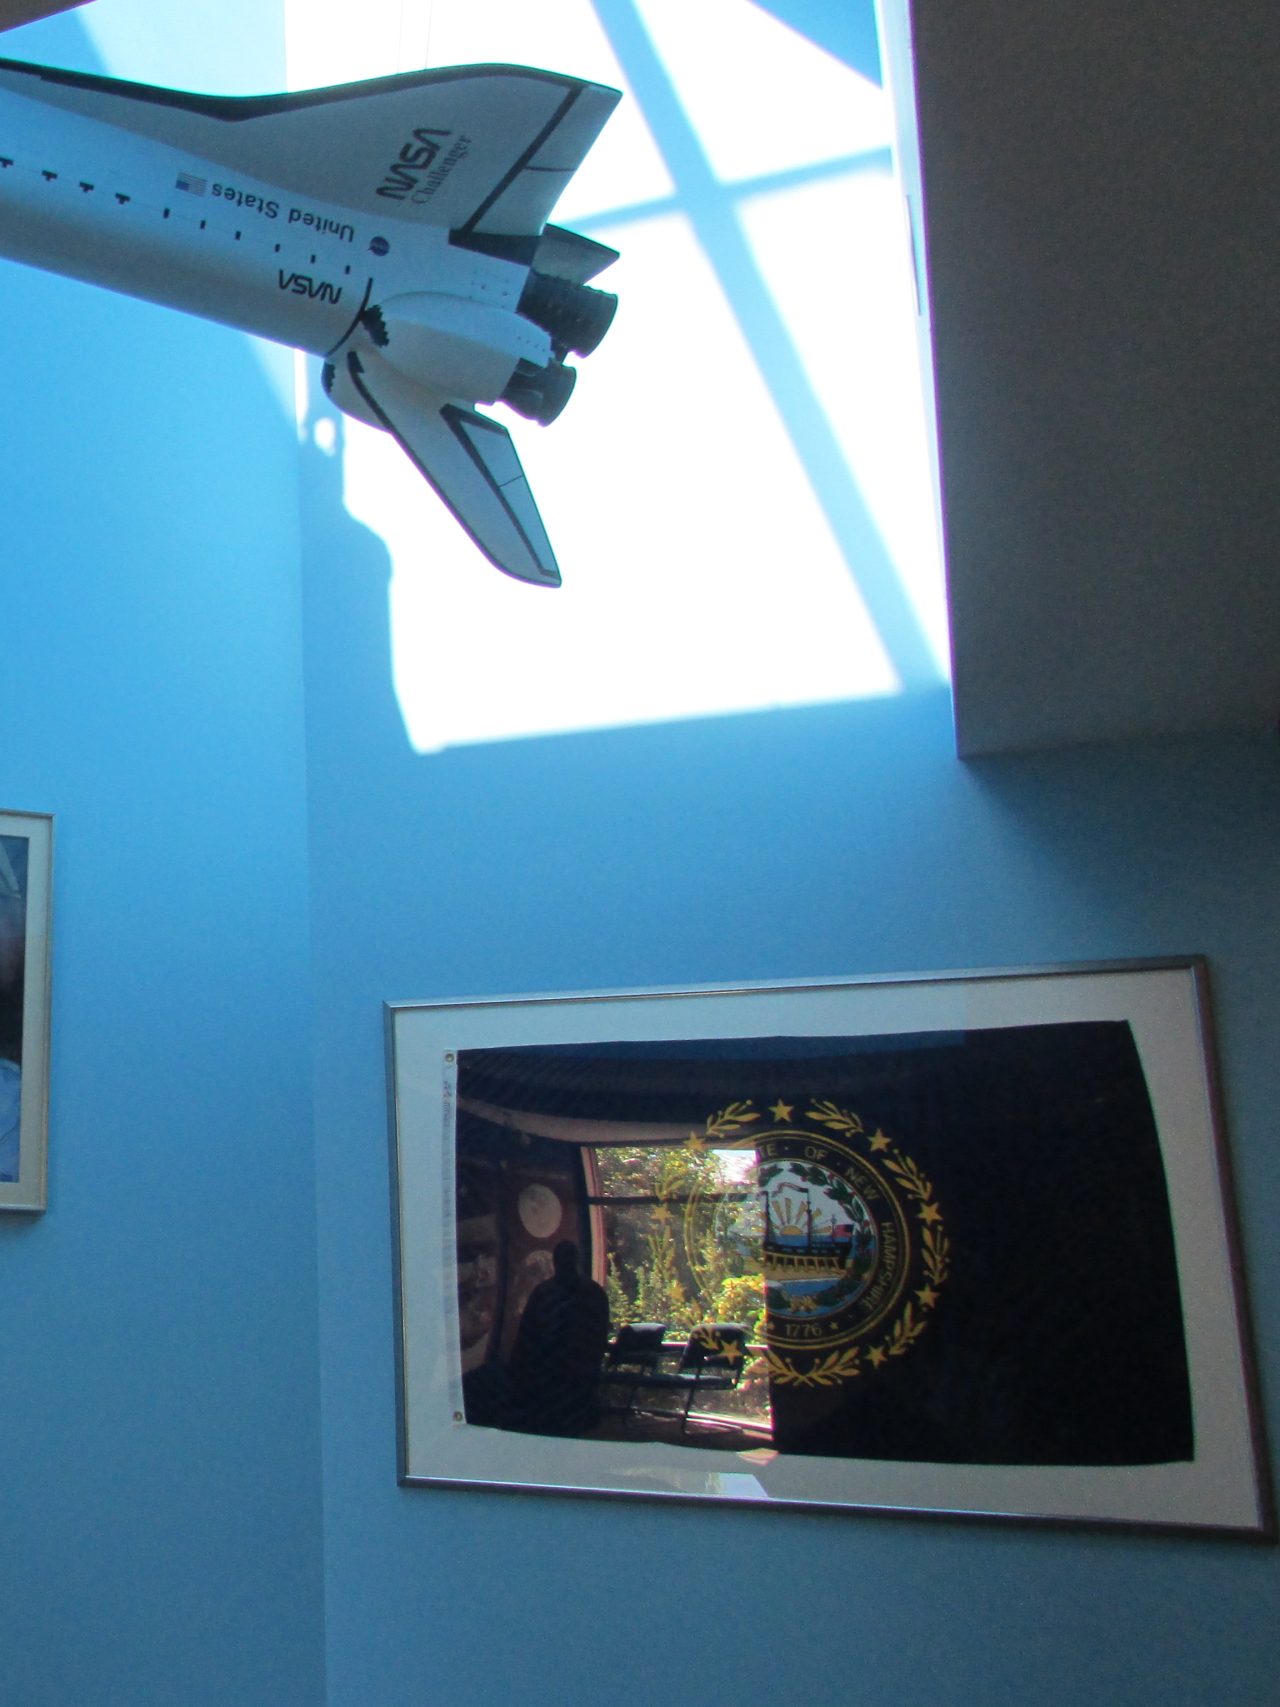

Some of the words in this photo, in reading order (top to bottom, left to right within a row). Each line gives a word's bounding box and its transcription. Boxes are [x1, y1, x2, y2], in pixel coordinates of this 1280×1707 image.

[376, 128, 452, 200] NASA
[411, 134, 472, 206] Challenger
[212, 181, 281, 220] States
[289, 208, 355, 243] United
[279, 269, 342, 305] NASA
[804, 1146, 828, 1160] OF
[845, 1167, 880, 1200] NEW
[785, 1323, 822, 1338] 1776
